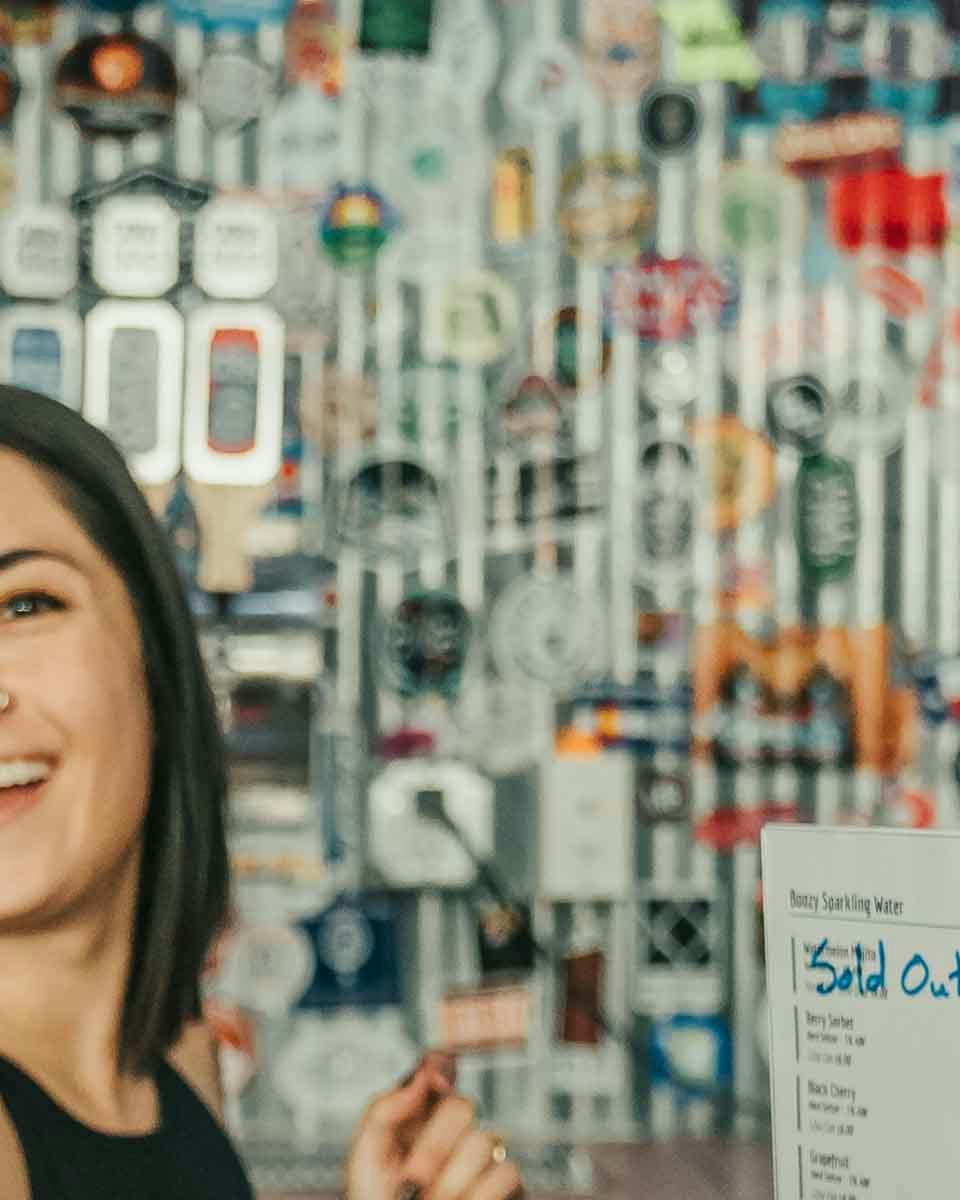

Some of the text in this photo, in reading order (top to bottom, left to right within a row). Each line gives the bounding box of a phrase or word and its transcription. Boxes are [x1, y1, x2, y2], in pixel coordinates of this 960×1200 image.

[789, 888, 905, 918] Boozy Sparkling Water
[809, 937, 886, 995] Sold
